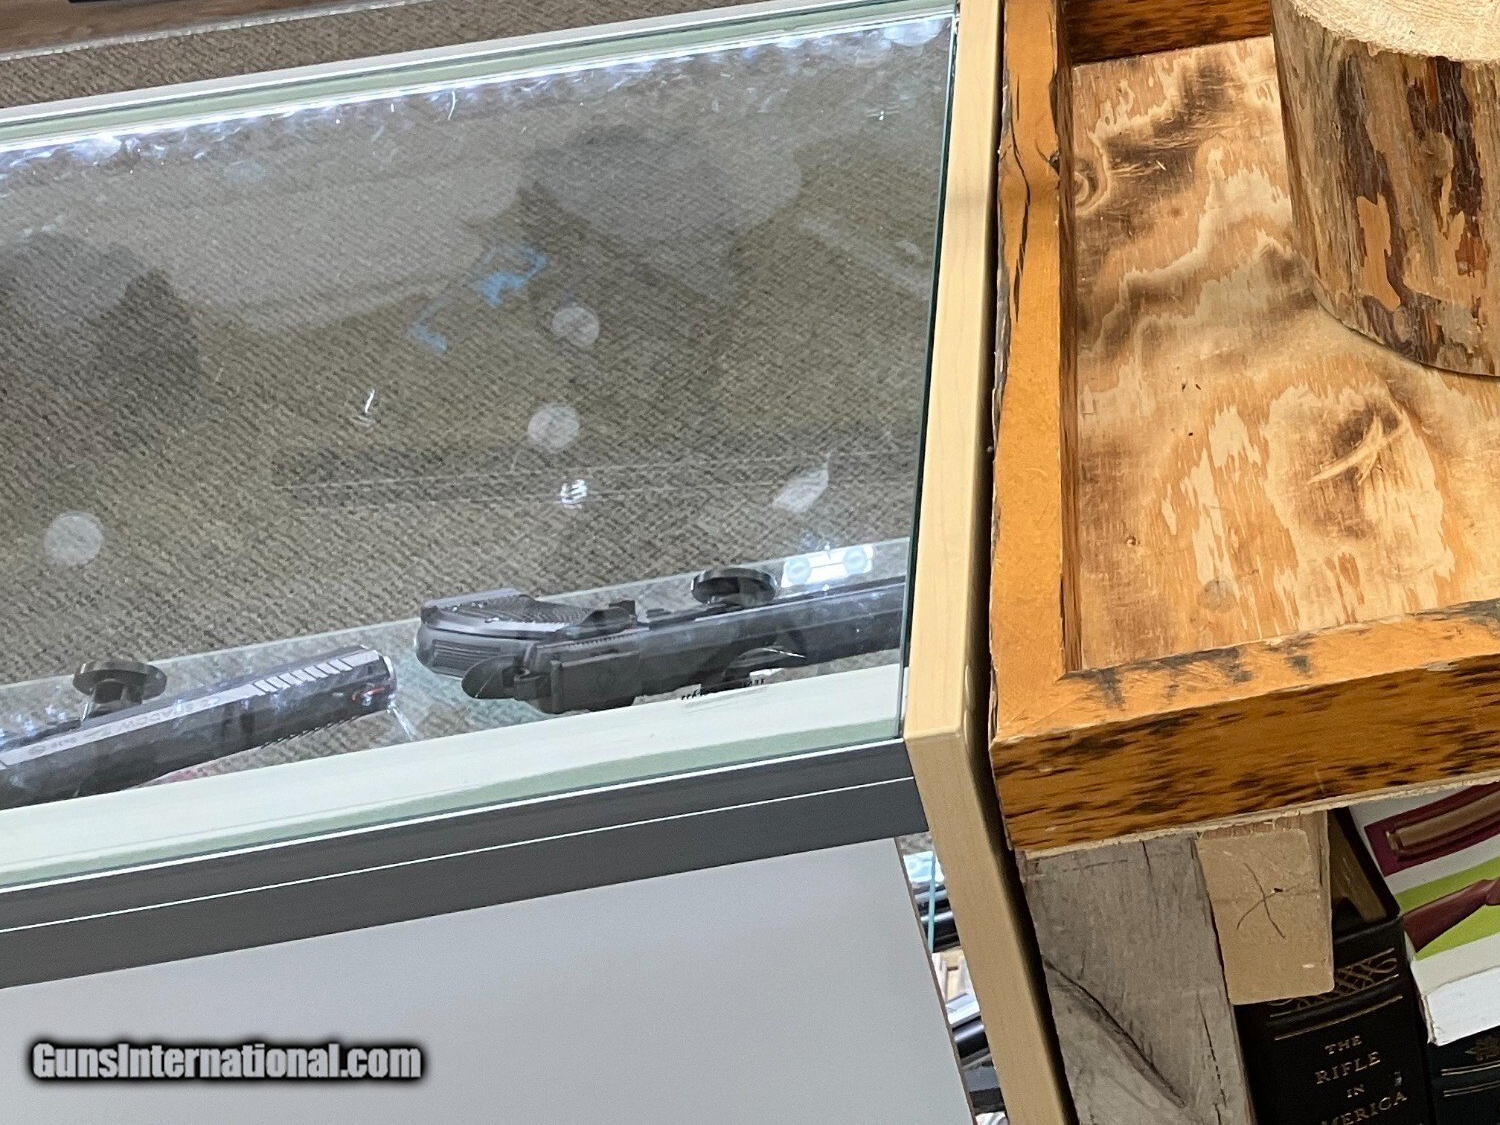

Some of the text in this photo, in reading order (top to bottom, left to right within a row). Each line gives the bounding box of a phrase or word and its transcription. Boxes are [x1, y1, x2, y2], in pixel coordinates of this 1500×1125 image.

[1325, 1035, 1364, 1056] THE
[1315, 1051, 1382, 1085] RIFLE
[1345, 1083, 1366, 1099] IN
[1320, 1090, 1409, 1125] MERICA
